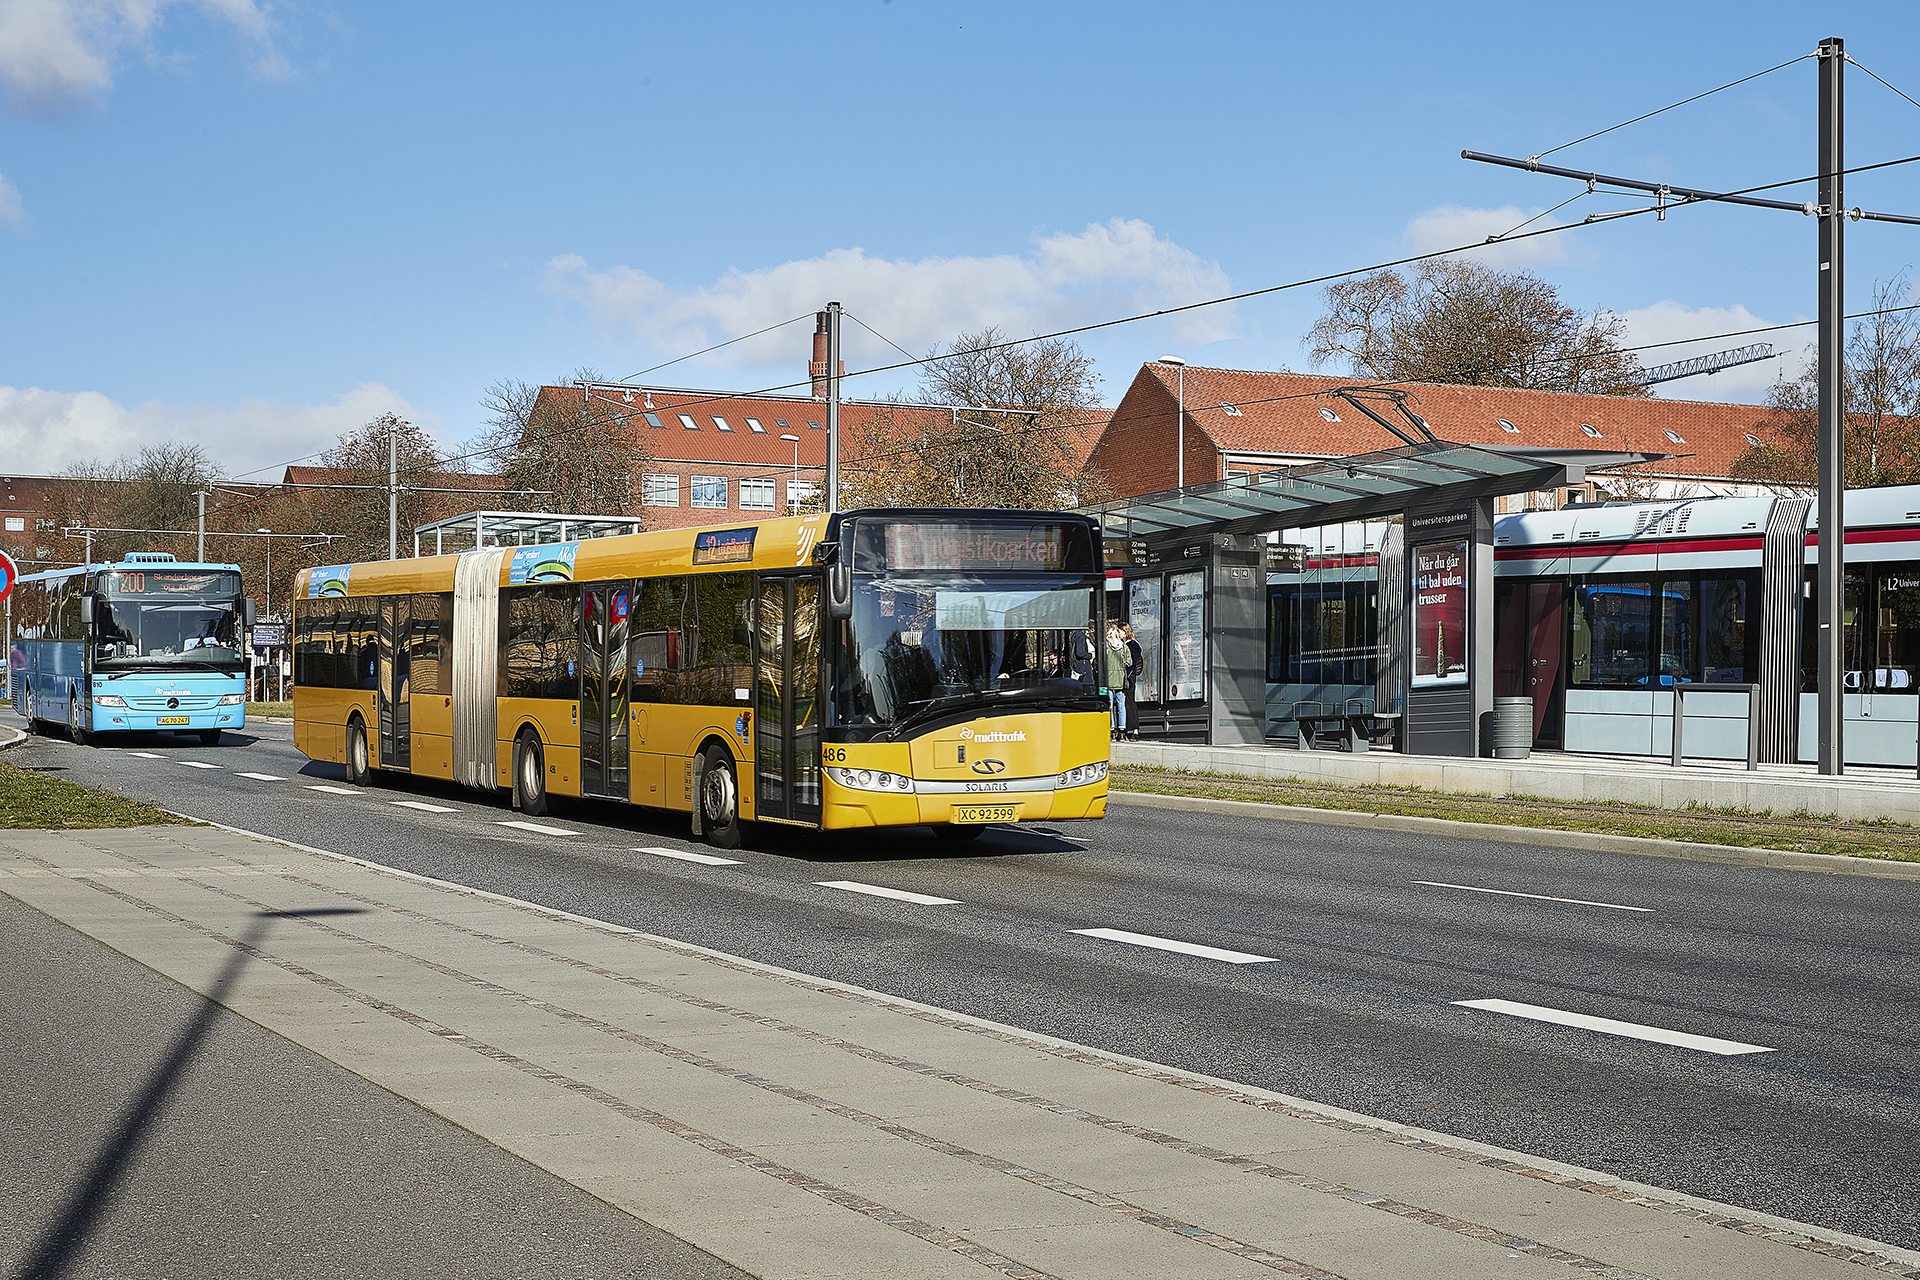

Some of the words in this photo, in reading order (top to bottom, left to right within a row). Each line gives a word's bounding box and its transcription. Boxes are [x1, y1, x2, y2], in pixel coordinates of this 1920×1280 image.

[1412, 513, 1468, 527] Universitetsparken
[1223, 537, 1230, 546] 2
[1252, 538, 1258, 547] 1
[928, 533, 1058, 568] Logistikparken
[1419, 556, 1434, 571] Når
[1434, 554, 1445, 569] du
[1446, 553, 1460, 571] går
[121, 573, 145, 592] 200
[1419, 574, 1427, 590] til
[1428, 572, 1441, 588] bal
[1442, 571, 1462, 587] uden
[1888, 578, 1899, 591] L2
[1419, 593, 1447, 605] trusser
[974, 730, 1027, 743] midttrafik
[822, 748, 846, 762] 486
[965, 783, 1008, 792] SOLARIS
[961, 810, 977, 820] XC
[978, 809, 992, 820] 92
[993, 808, 1013, 820] 599
